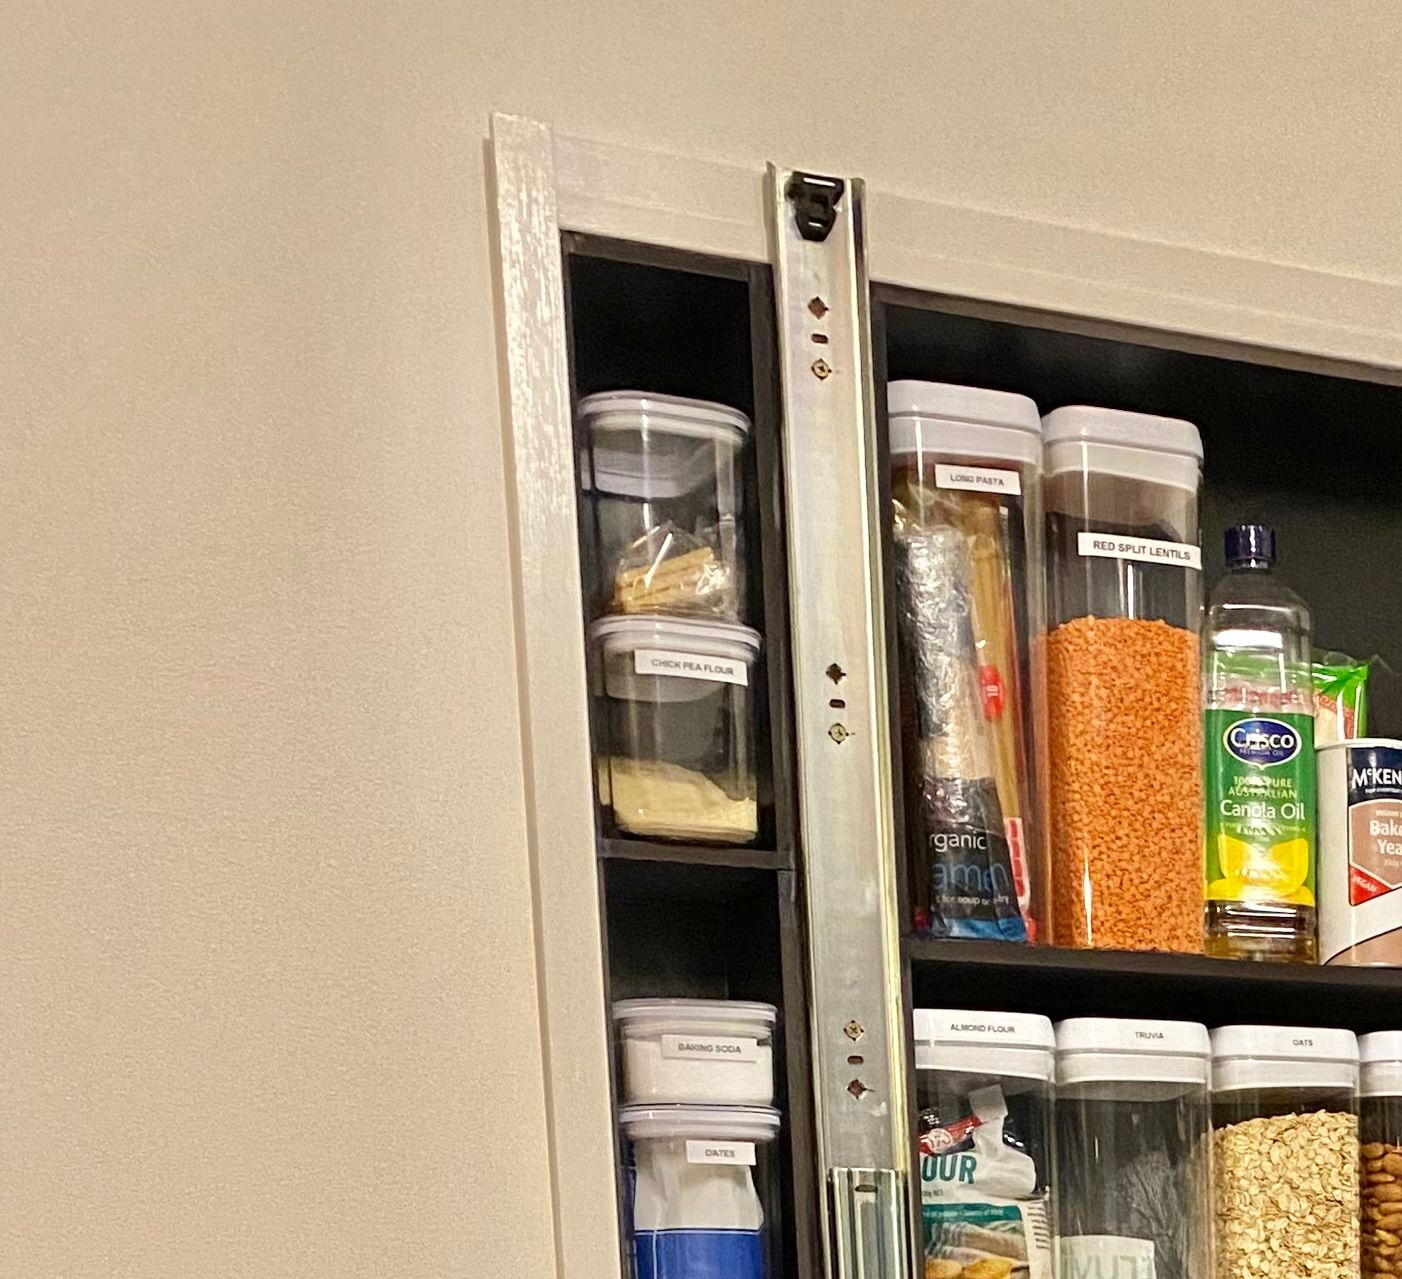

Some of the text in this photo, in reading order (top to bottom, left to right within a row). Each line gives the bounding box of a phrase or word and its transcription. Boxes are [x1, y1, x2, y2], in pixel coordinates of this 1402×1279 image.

[950, 473, 1005, 486] LONG PASTA
[1093, 540, 1191, 560] RED SPLIT LENTILS
[651, 659, 734, 675] CHICK PEA FLOUR
[1230, 727, 1295, 749] Crisco
[1220, 799, 1306, 820] Canola Oil
[928, 830, 987, 853] rganic
[950, 1023, 1016, 1033] ALMOND FLOUR
[678, 1043, 742, 1054] BAKING SODA
[704, 1148, 735, 1158] DATES
[921, 1153, 977, 1184] OUR
